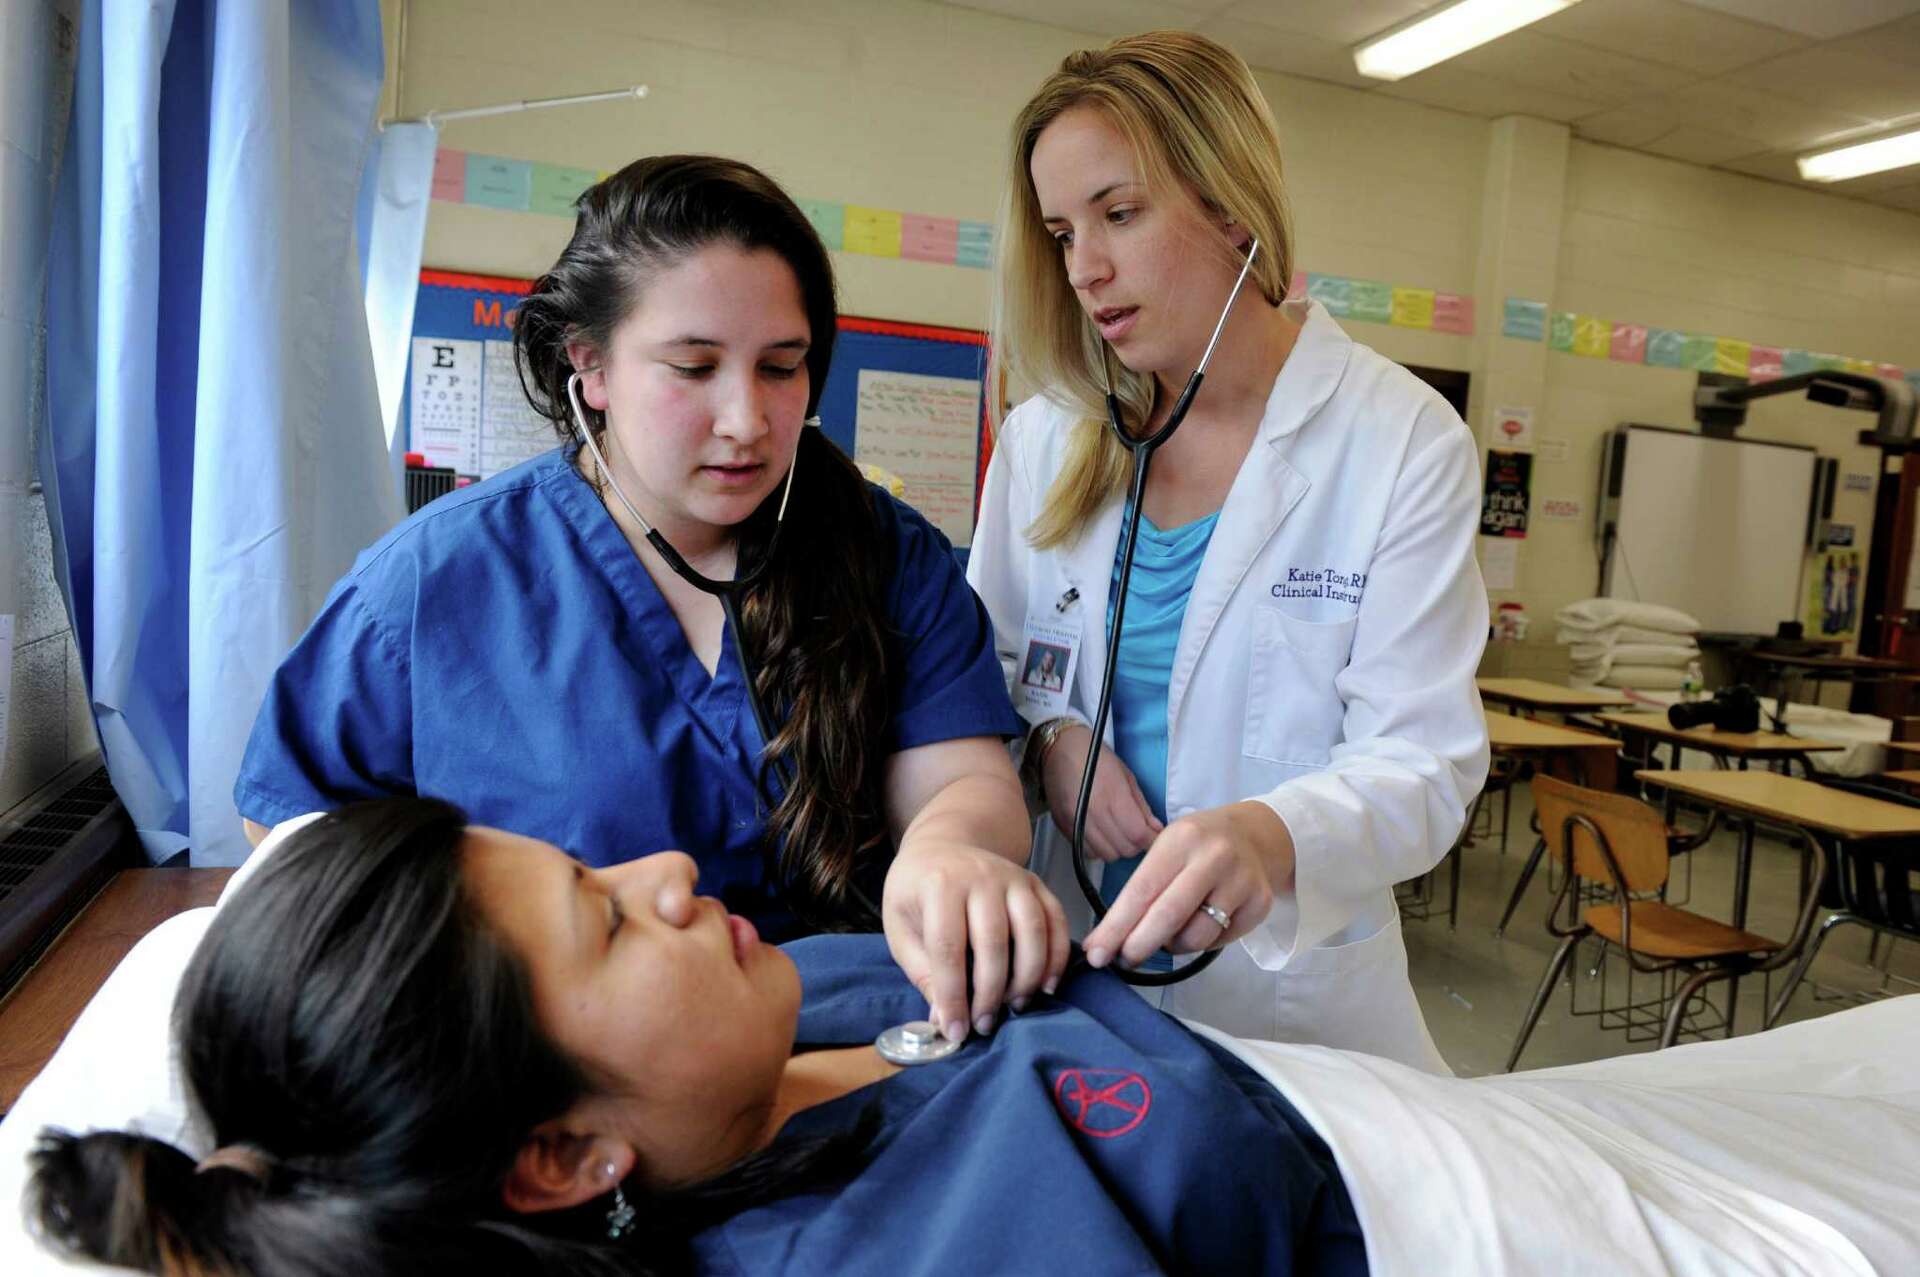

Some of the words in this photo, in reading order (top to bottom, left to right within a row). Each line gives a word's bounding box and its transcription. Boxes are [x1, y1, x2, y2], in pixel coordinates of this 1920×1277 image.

[432, 346, 454, 368] E
[1288, 568, 1322, 582] Katie
[1271, 584, 1322, 598] Clinical
